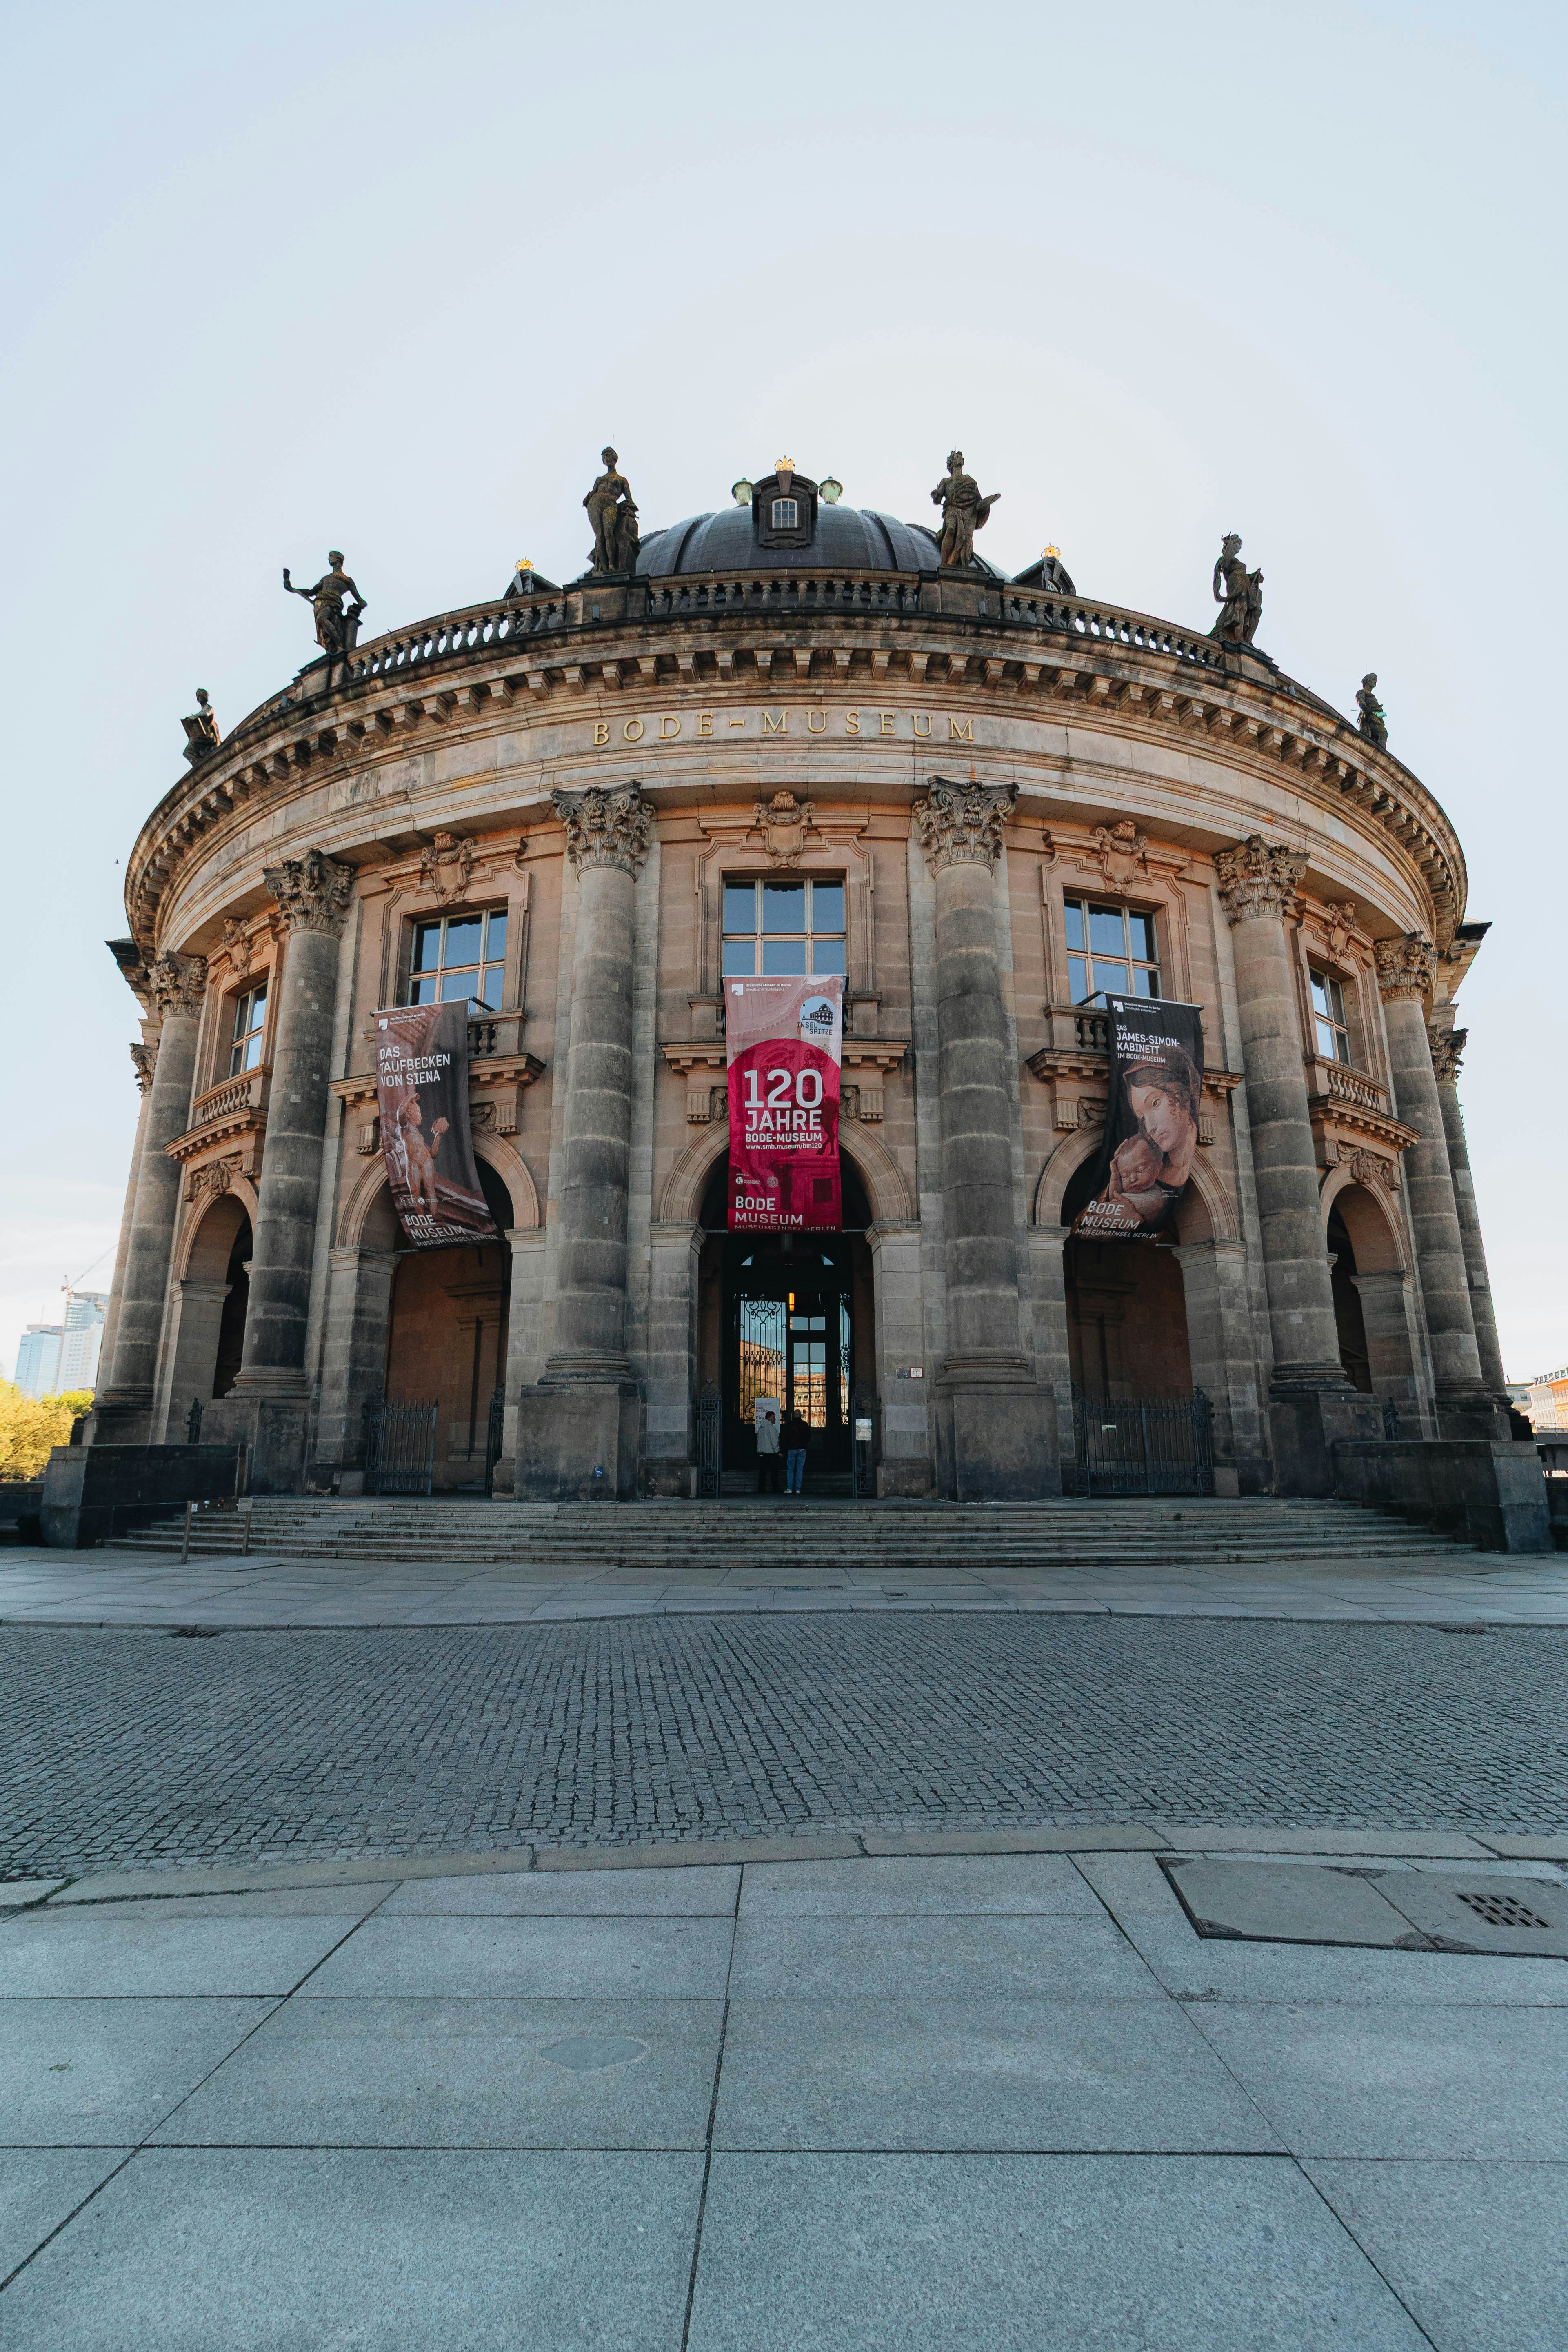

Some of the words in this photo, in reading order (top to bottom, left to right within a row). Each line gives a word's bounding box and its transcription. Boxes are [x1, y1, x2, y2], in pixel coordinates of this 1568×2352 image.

[1117, 1032, 1180, 1047] JAMES-SIMON-
[380, 1046, 400, 1060] DAS
[1117, 1042, 1160, 1055] KABINETT
[380, 1053, 451, 1074] TAUFBECKEN
[1126, 1053, 1166, 1064] BODE-MUSEUM
[381, 1074, 403, 1088] VON
[406, 1070, 440, 1085] SIENA
[744, 1069, 822, 1108] 120
[745, 1110, 822, 1131] JAHRE
[746, 1133, 822, 1142] BODE-MUSEUM
[735, 1196, 775, 1211] BODE
[1087, 1200, 1124, 1216] BODE
[404, 1214, 437, 1226] BODE
[735, 1212, 803, 1225] MUSEUM
[1081, 1215, 1140, 1230] MUSEUM
[410, 1226, 466, 1239] MUSEUM
[1075, 1228, 1130, 1237] MUSEUMSINSEL
[416, 1236, 471, 1247] MUSEUMSINSEL
